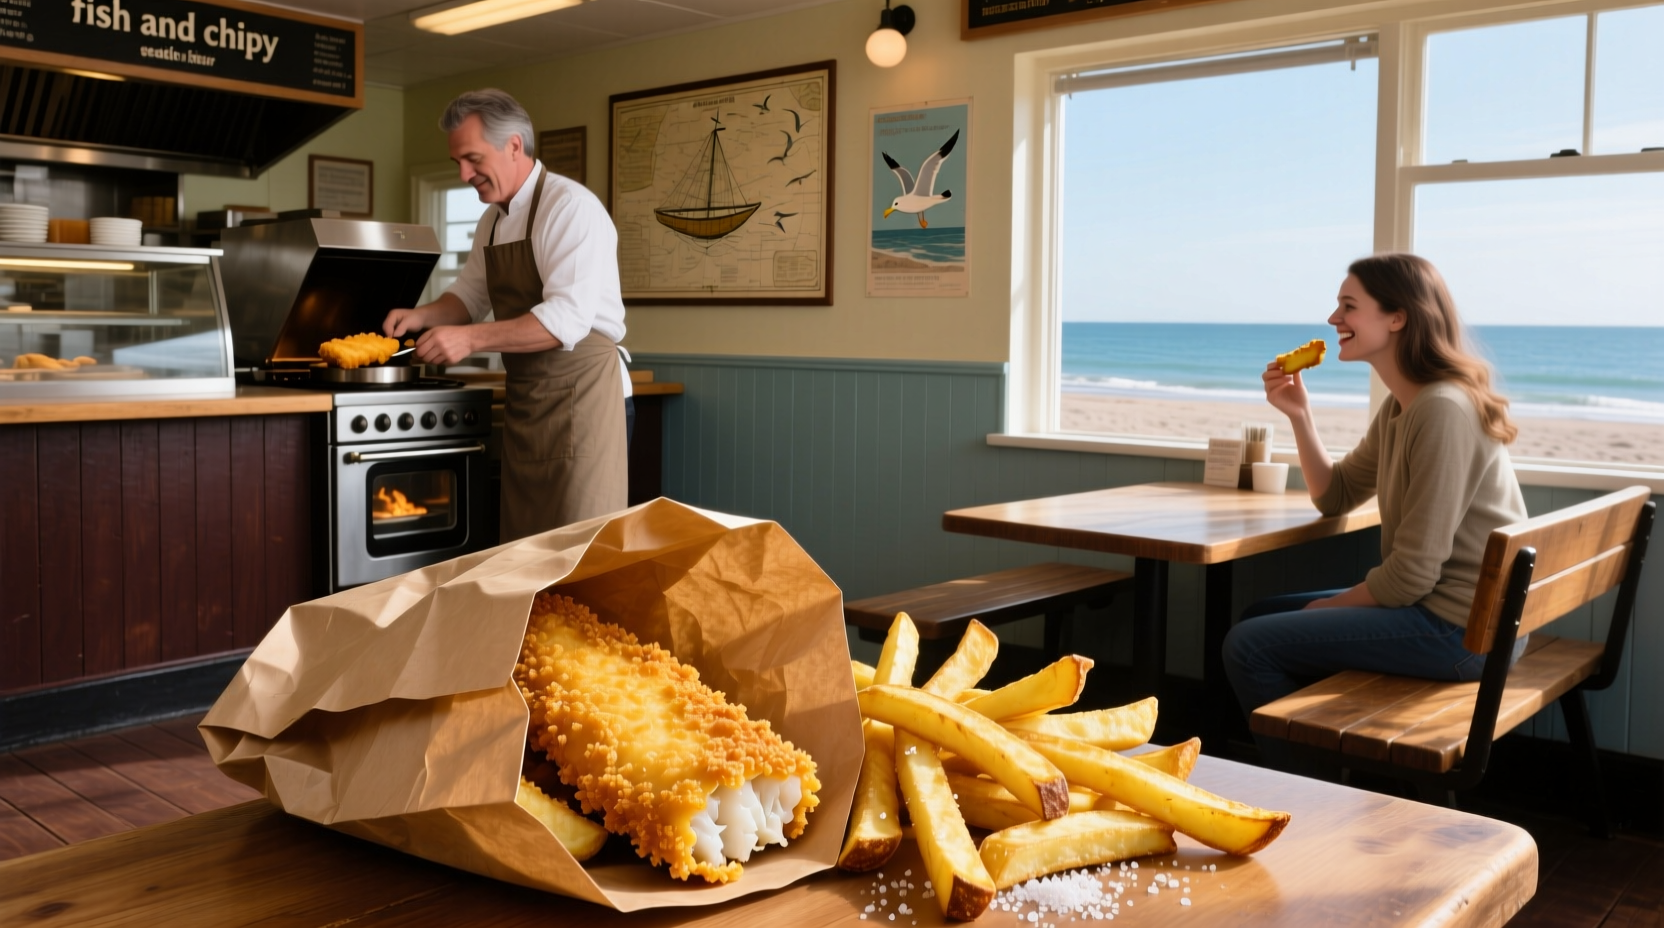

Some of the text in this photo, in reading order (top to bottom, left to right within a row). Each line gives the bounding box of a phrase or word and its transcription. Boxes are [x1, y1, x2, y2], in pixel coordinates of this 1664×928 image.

[71, 0, 131, 33] fish
[139, 12, 196, 43] and
[203, 17, 280, 64] chipy
